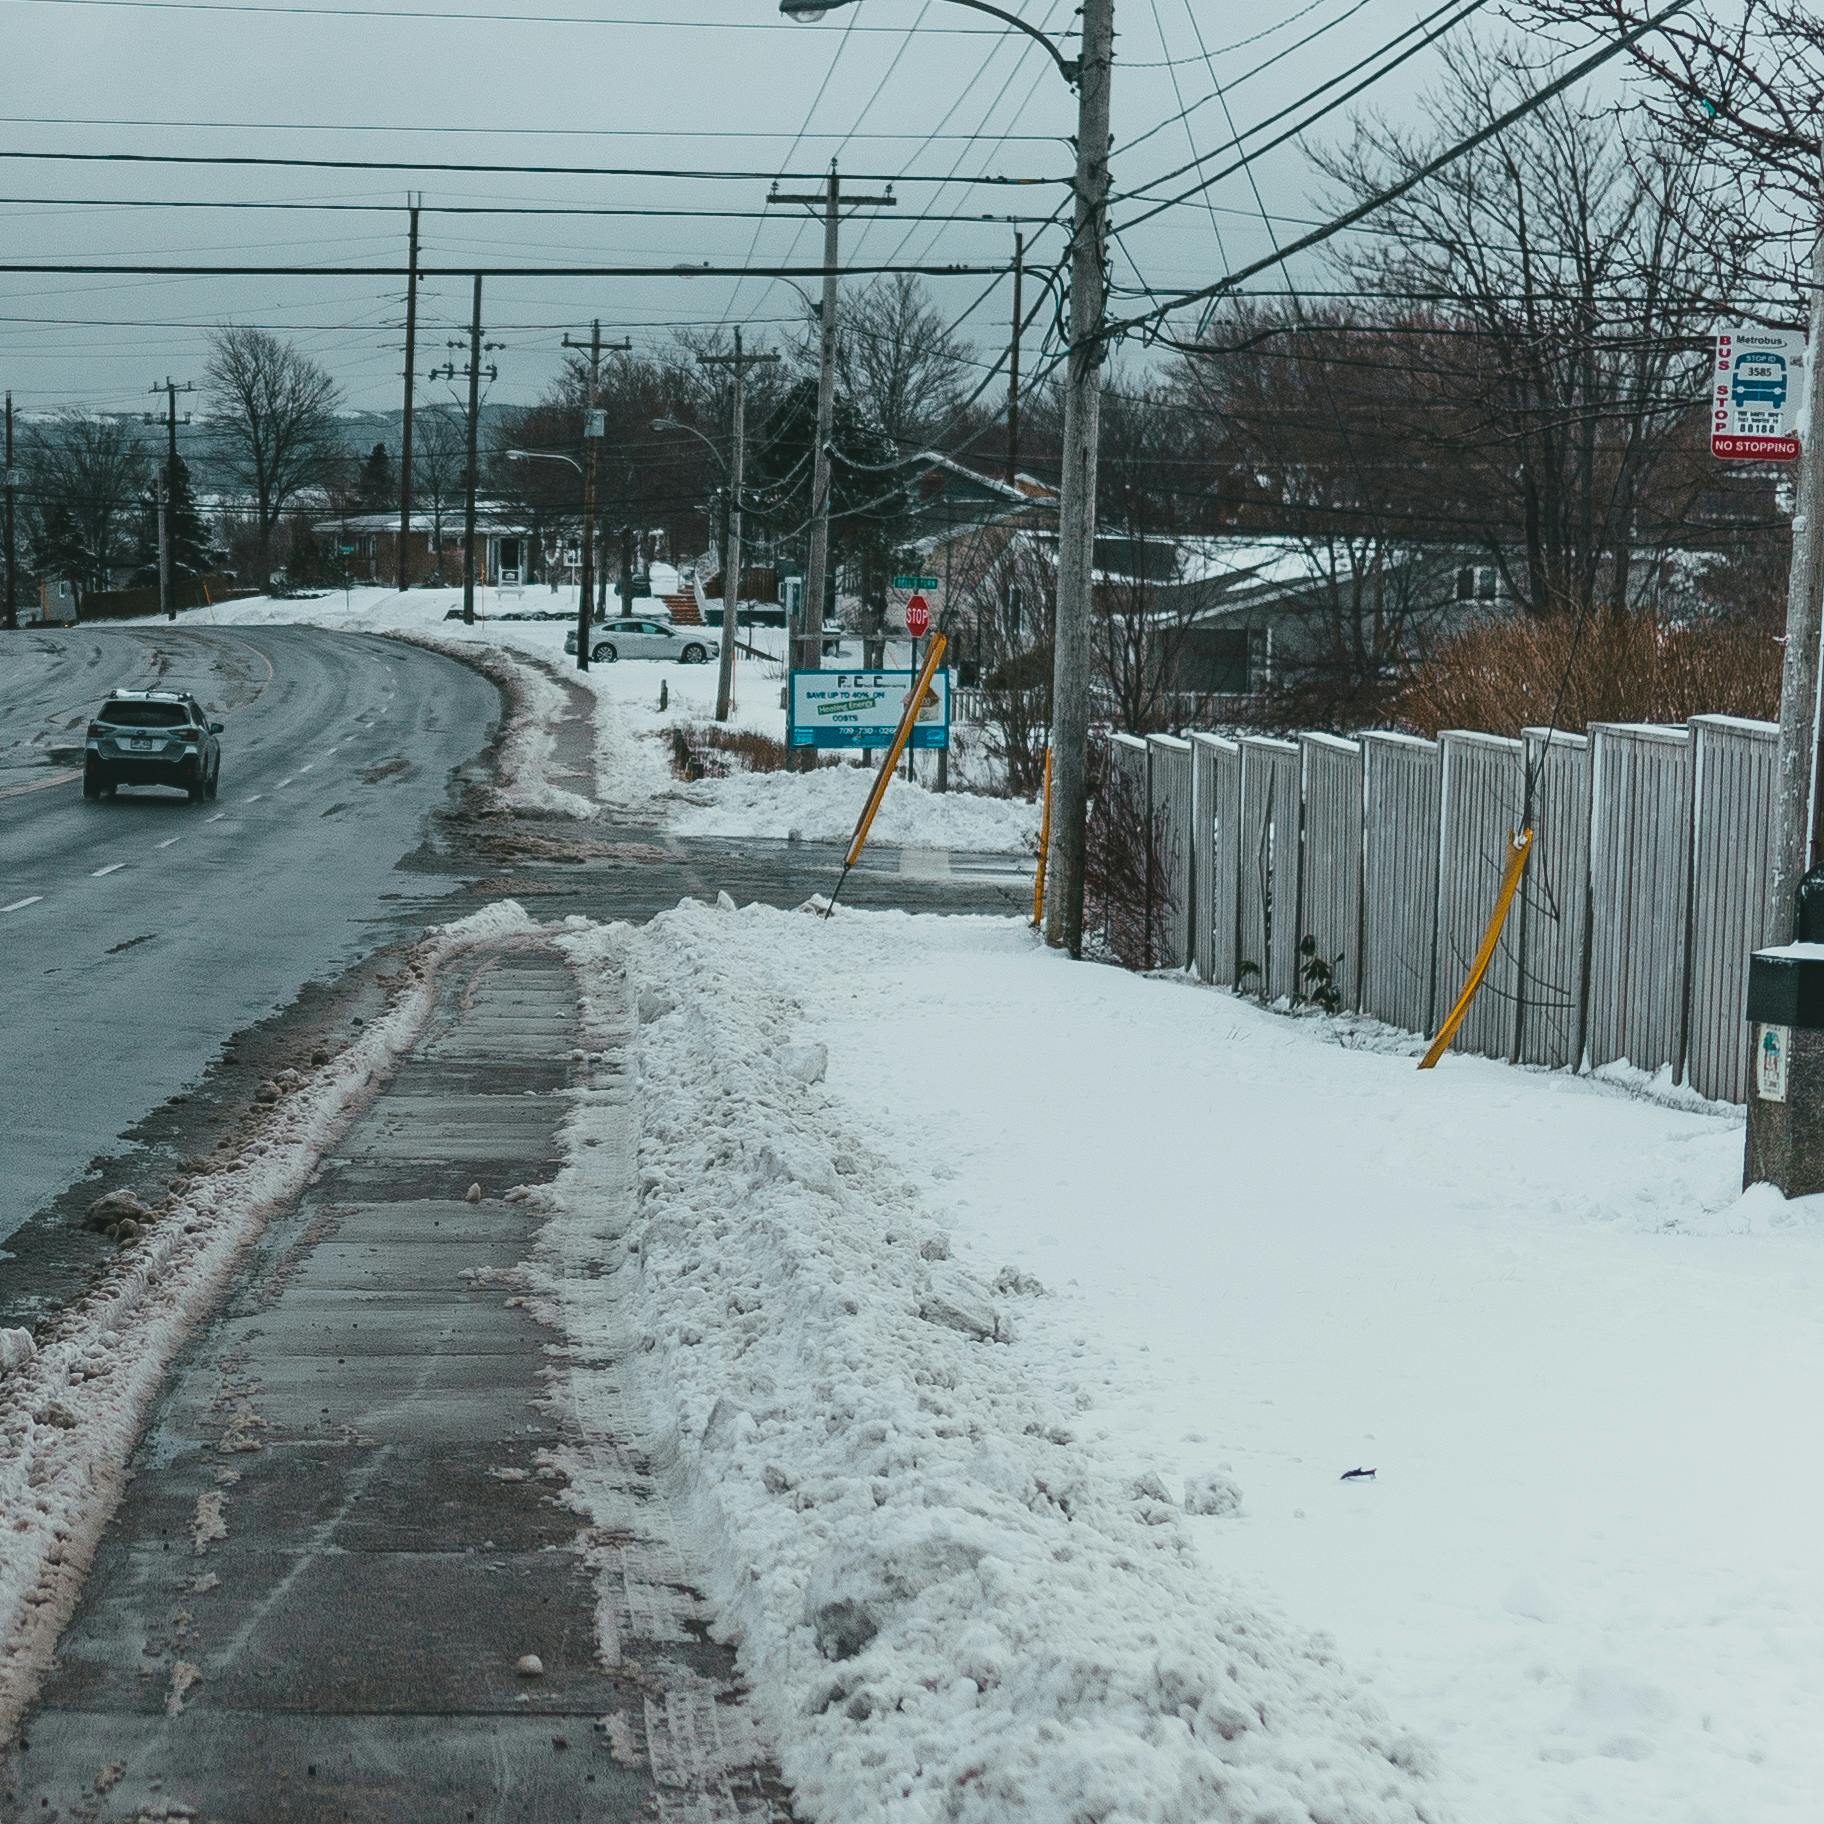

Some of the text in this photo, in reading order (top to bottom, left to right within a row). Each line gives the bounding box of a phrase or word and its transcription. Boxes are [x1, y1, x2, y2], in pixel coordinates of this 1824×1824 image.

[1736, 335, 1783, 345] Metrobus
[1718, 336, 1731, 370] BUS
[1747, 367, 1772, 377] 3585
[1715, 385, 1728, 432] STOP
[1715, 440, 1796, 454] NO STOPPING
[906, 607, 929, 625] STOP
[806, 691, 885, 699] SAVE UP TO 40% ON
